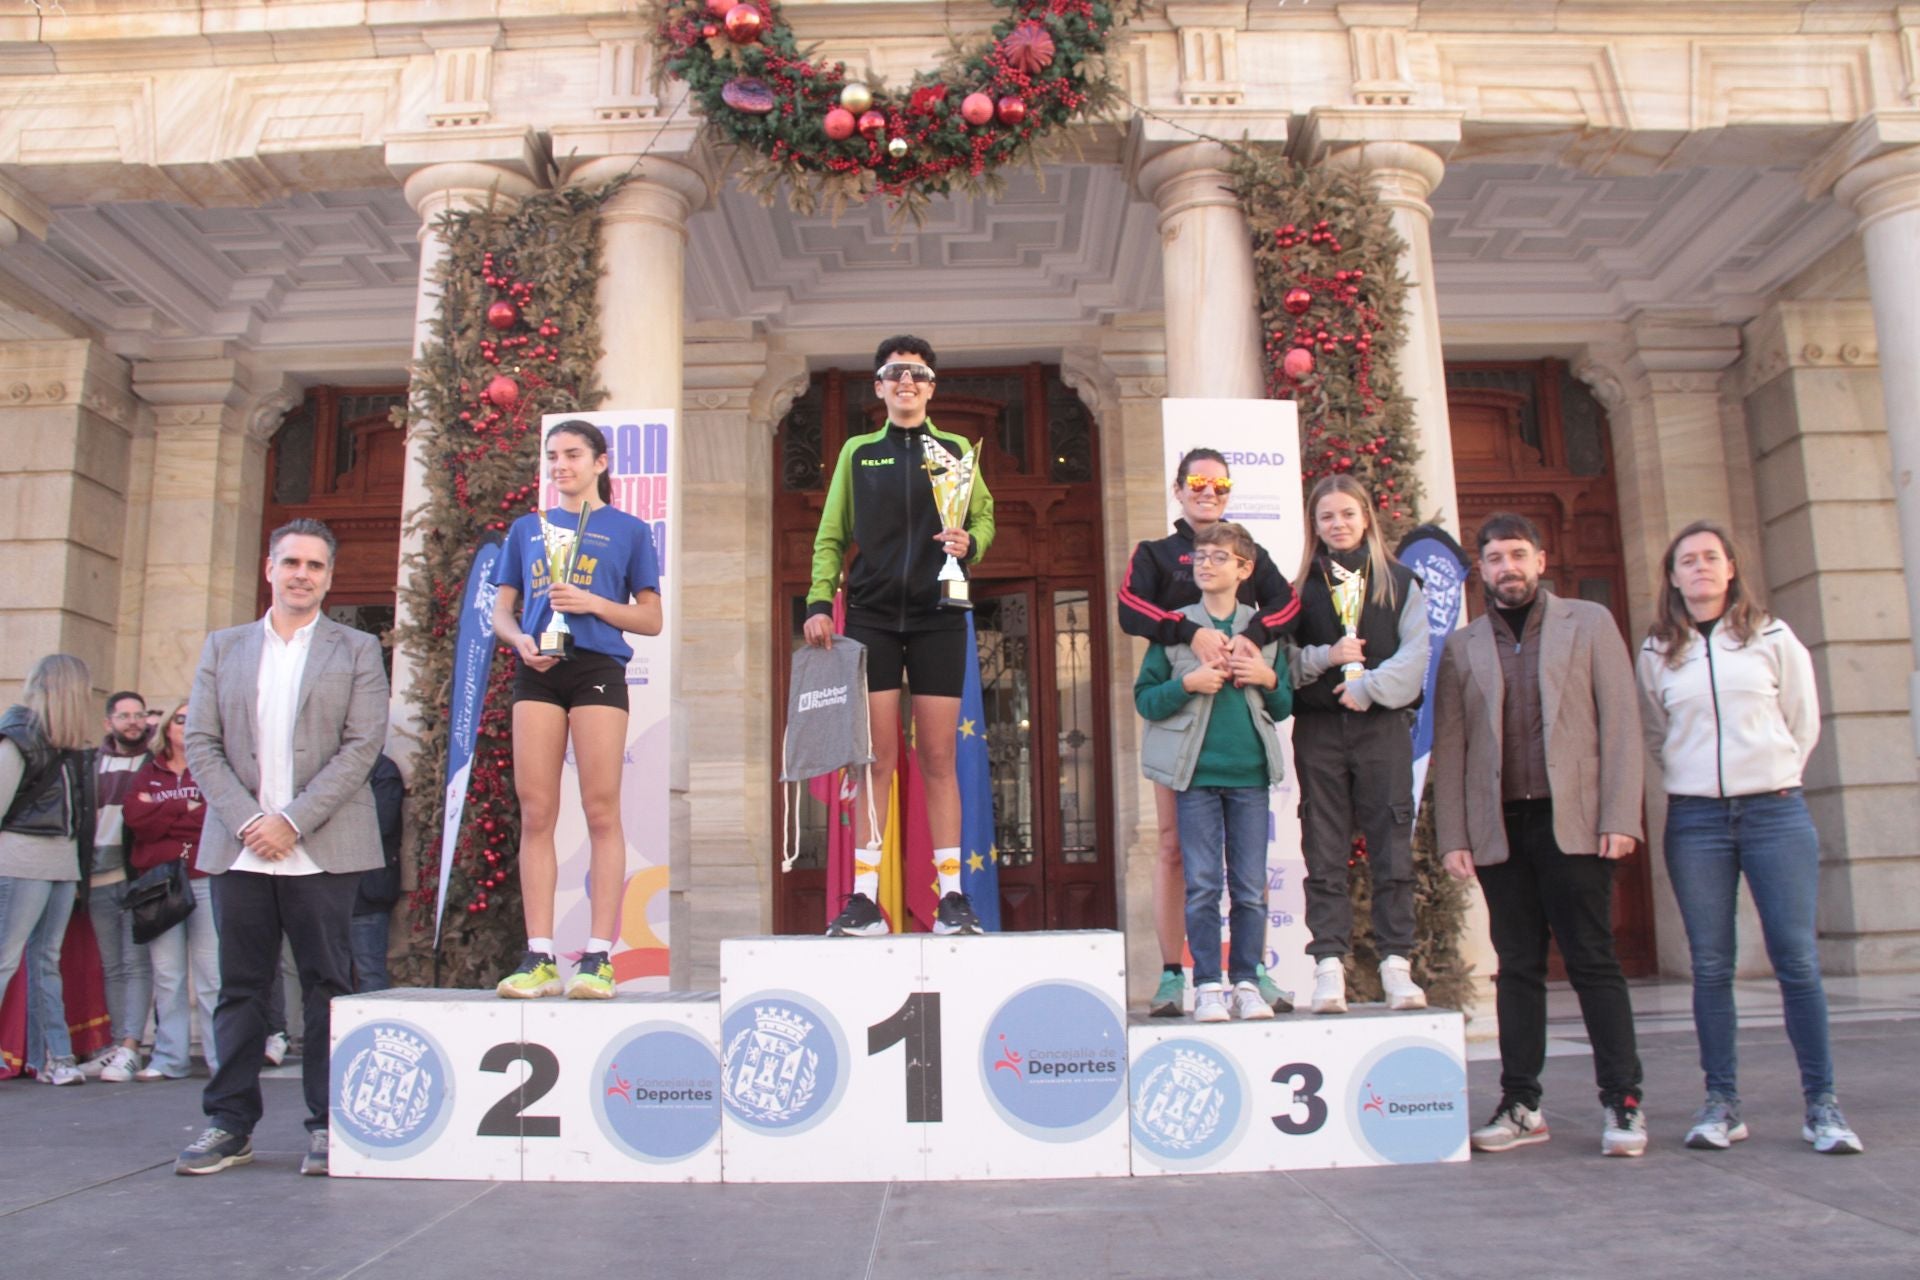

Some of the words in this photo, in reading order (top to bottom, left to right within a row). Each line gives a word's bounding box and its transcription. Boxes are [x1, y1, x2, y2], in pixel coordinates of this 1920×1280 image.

[861, 457, 895, 466] KELME
[1222, 451, 1285, 466] ERDAD
[867, 991, 943, 1123] 1
[1099, 1045, 1117, 1058] de
[1028, 1060, 1116, 1077] Deportes
[477, 1041, 560, 1137] 2
[636, 1088, 712, 1103] Deportes
[1271, 1062, 1328, 1135] 3
[1389, 1101, 1454, 1115] Deportes
